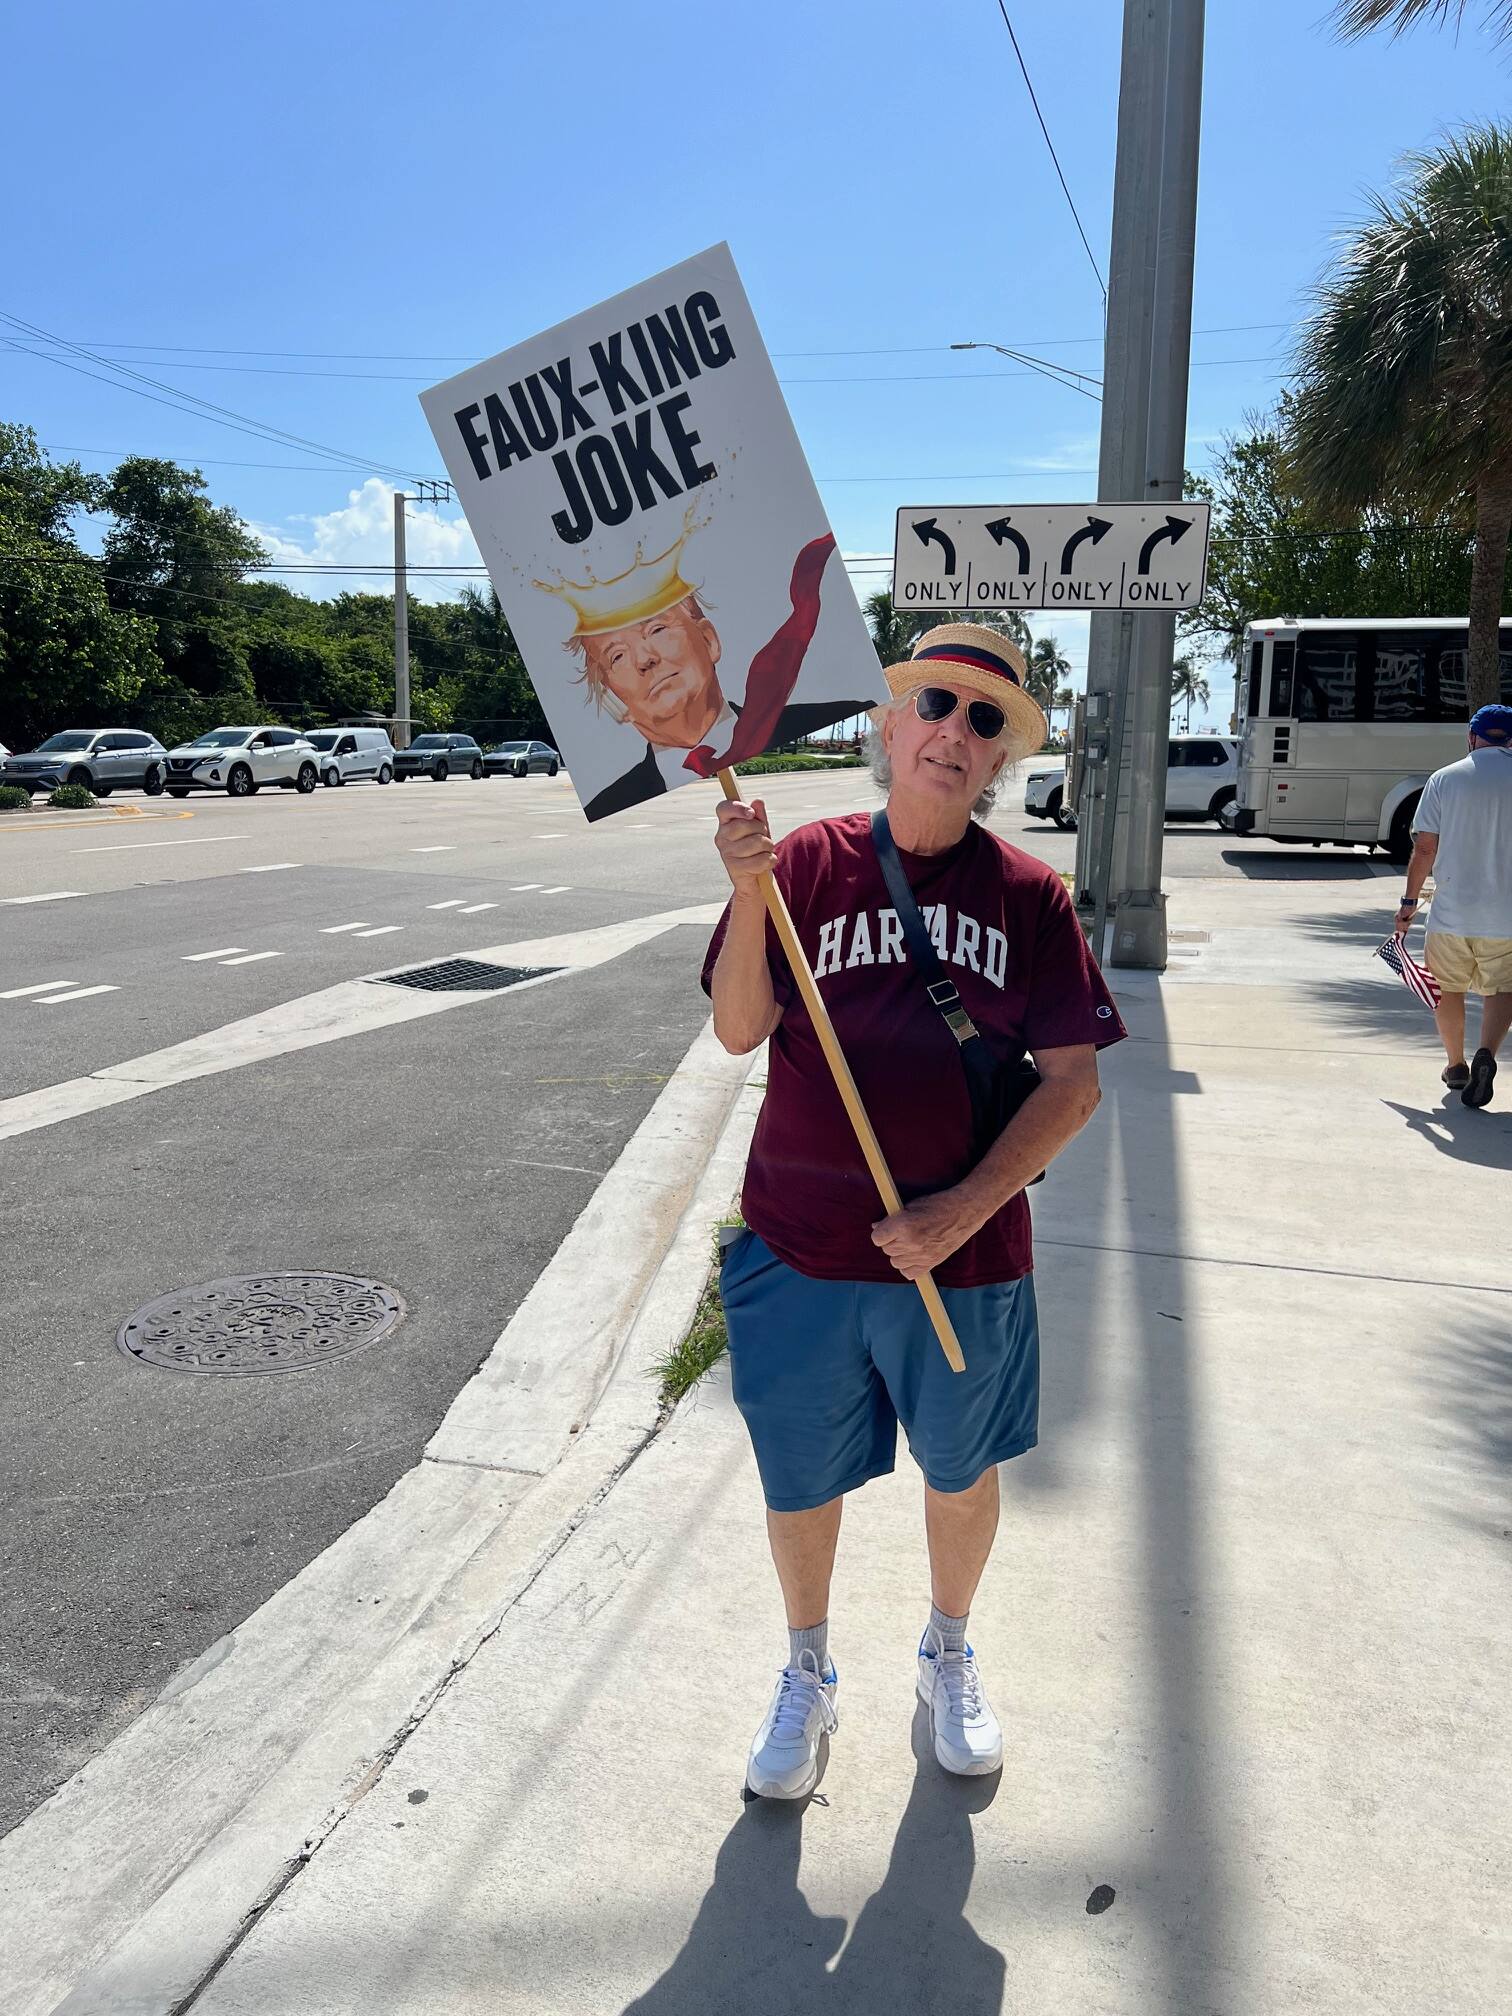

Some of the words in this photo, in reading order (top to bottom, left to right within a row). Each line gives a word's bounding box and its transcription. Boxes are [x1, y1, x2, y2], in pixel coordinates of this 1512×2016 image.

[454, 291, 737, 481] FAUX-KING
[551, 392, 718, 545] JOKE
[904, 581, 963, 601] ONLY
[977, 581, 1037, 601] ONLY
[1051, 581, 1113, 601] ONLY
[1128, 581, 1192, 602] ONLY
